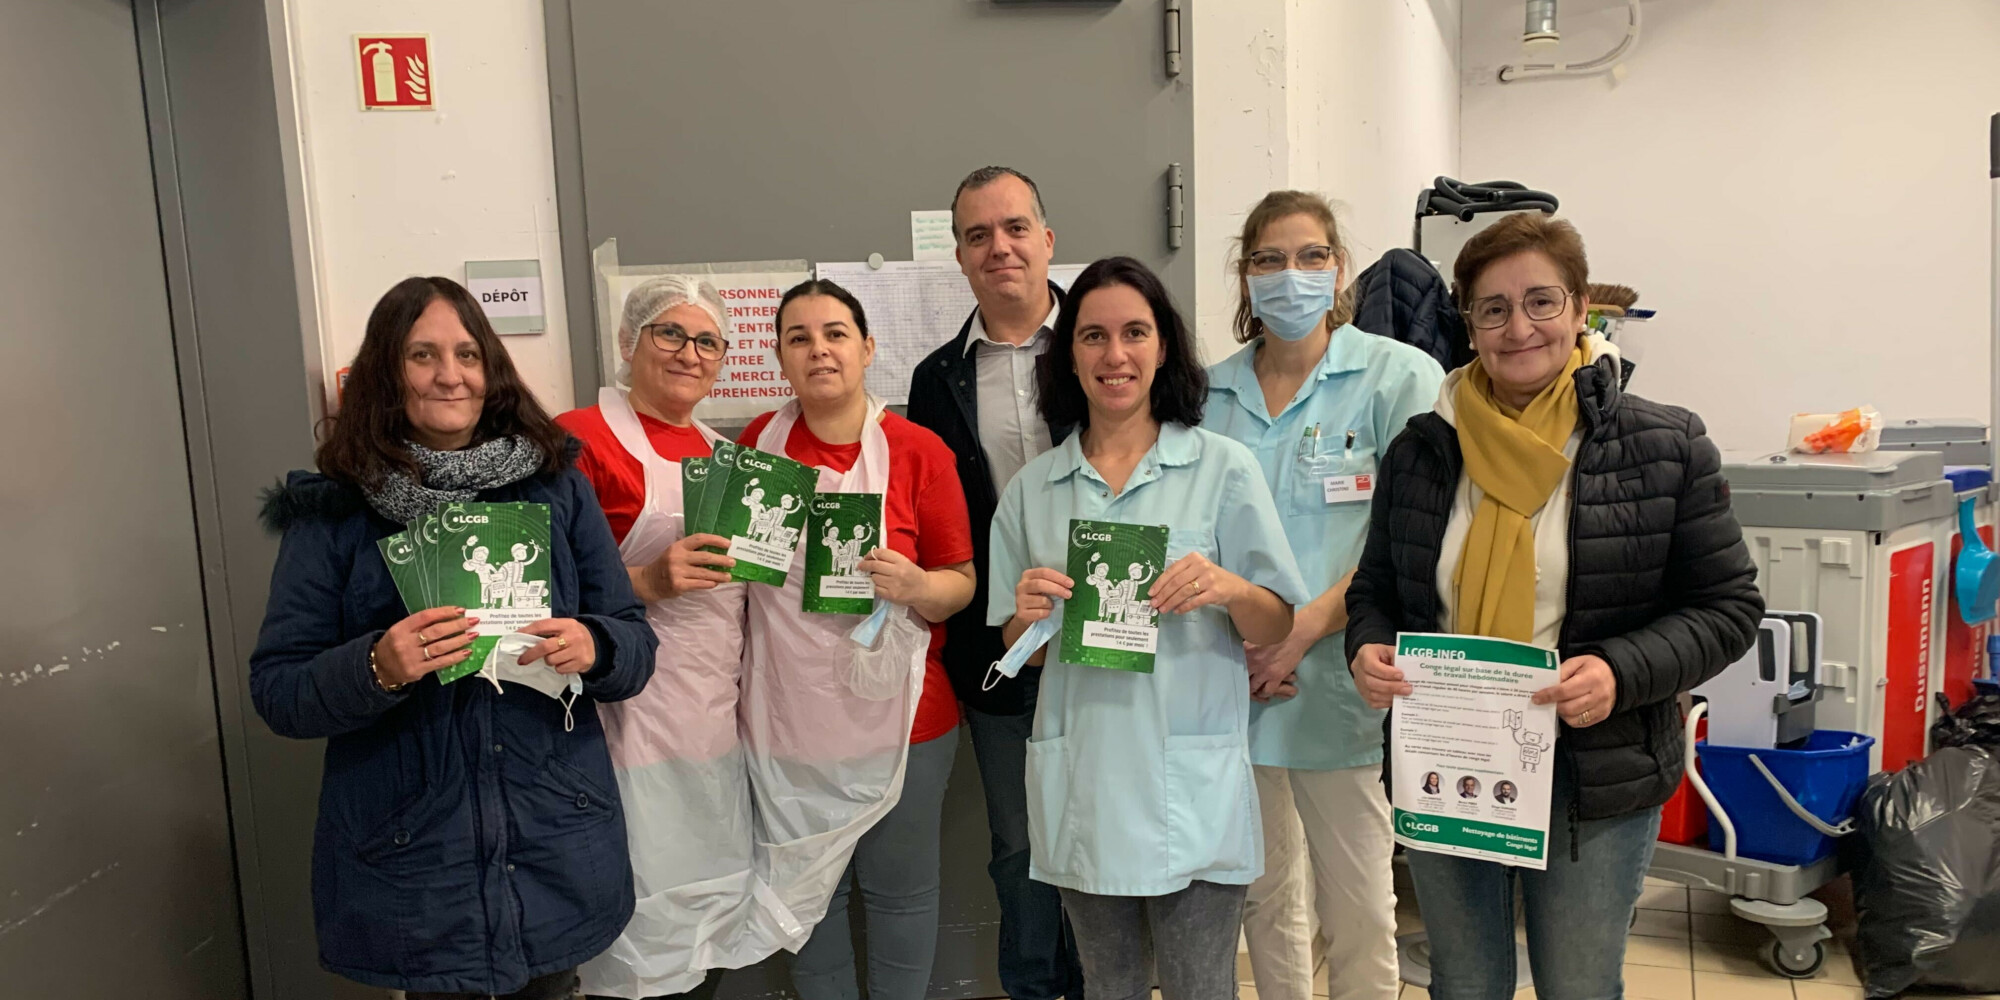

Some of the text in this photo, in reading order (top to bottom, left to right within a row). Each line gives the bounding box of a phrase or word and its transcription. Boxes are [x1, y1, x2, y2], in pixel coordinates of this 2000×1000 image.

[482, 288, 528, 302] DÉPÔT
[718, 288, 784, 299] RSONNEL
[727, 306, 778, 317] ENTRER
[738, 339, 754, 349] ET
[759, 338, 778, 349] NO
[731, 371, 775, 381] MERCI
[748, 458, 773, 472] LCGB
[821, 502, 841, 510] LCGB
[459, 515, 489, 524] LCGB
[1086, 532, 1112, 542] LCGB
[1915, 578, 1930, 713] Dussmann
[1404, 647, 1466, 660] LCGB-INFO
[1411, 822, 1439, 833] LCGB
